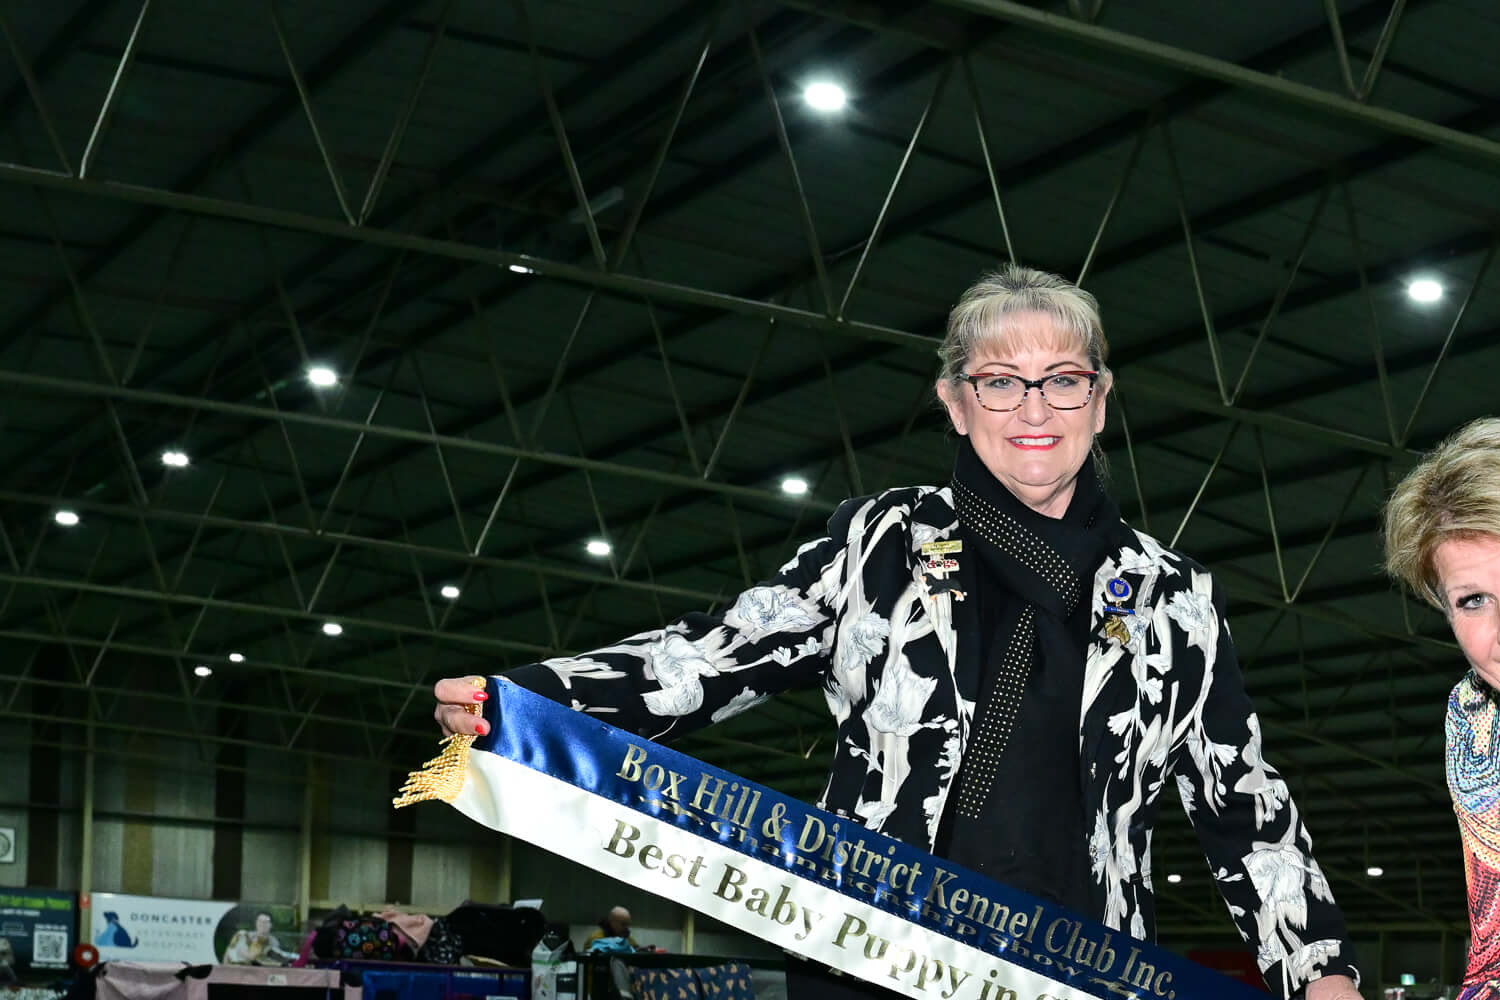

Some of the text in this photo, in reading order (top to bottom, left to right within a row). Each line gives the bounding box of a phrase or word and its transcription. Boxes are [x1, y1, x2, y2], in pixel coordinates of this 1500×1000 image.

[130, 912, 212, 926] DONCASTER
[603, 819, 708, 888] Best
[713, 863, 824, 940] Baby
[832, 912, 973, 999] Puppy
[616, 743, 1176, 1000] Box Hill & District Kennel Club Inc.
